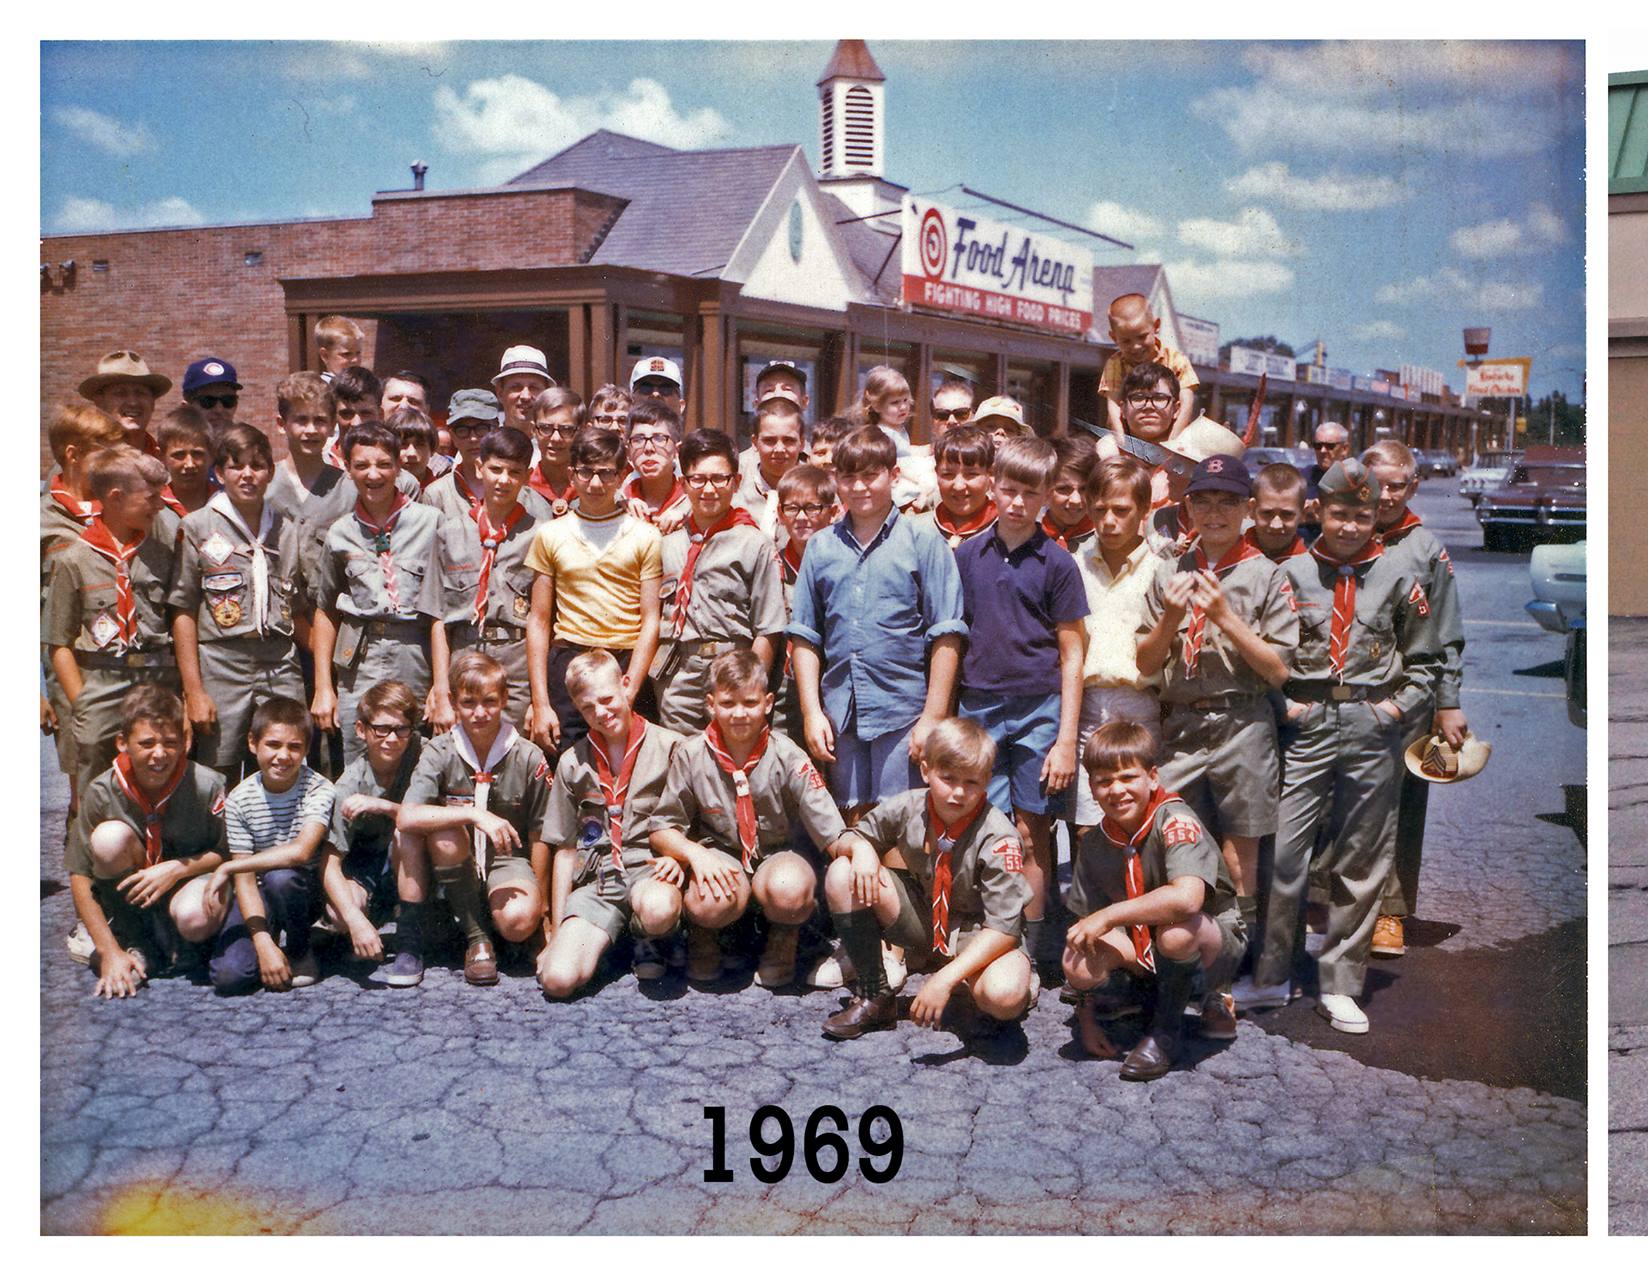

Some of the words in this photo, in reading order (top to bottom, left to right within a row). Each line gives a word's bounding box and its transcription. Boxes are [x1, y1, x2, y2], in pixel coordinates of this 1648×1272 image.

[952, 217, 1009, 280] Food
[1003, 237, 1076, 295] Arena
[923, 282, 982, 311] FIGHTING
[985, 295, 1013, 316] HIGH
[1016, 301, 1044, 324] FOOD
[1048, 308, 1082, 330] PRICES
